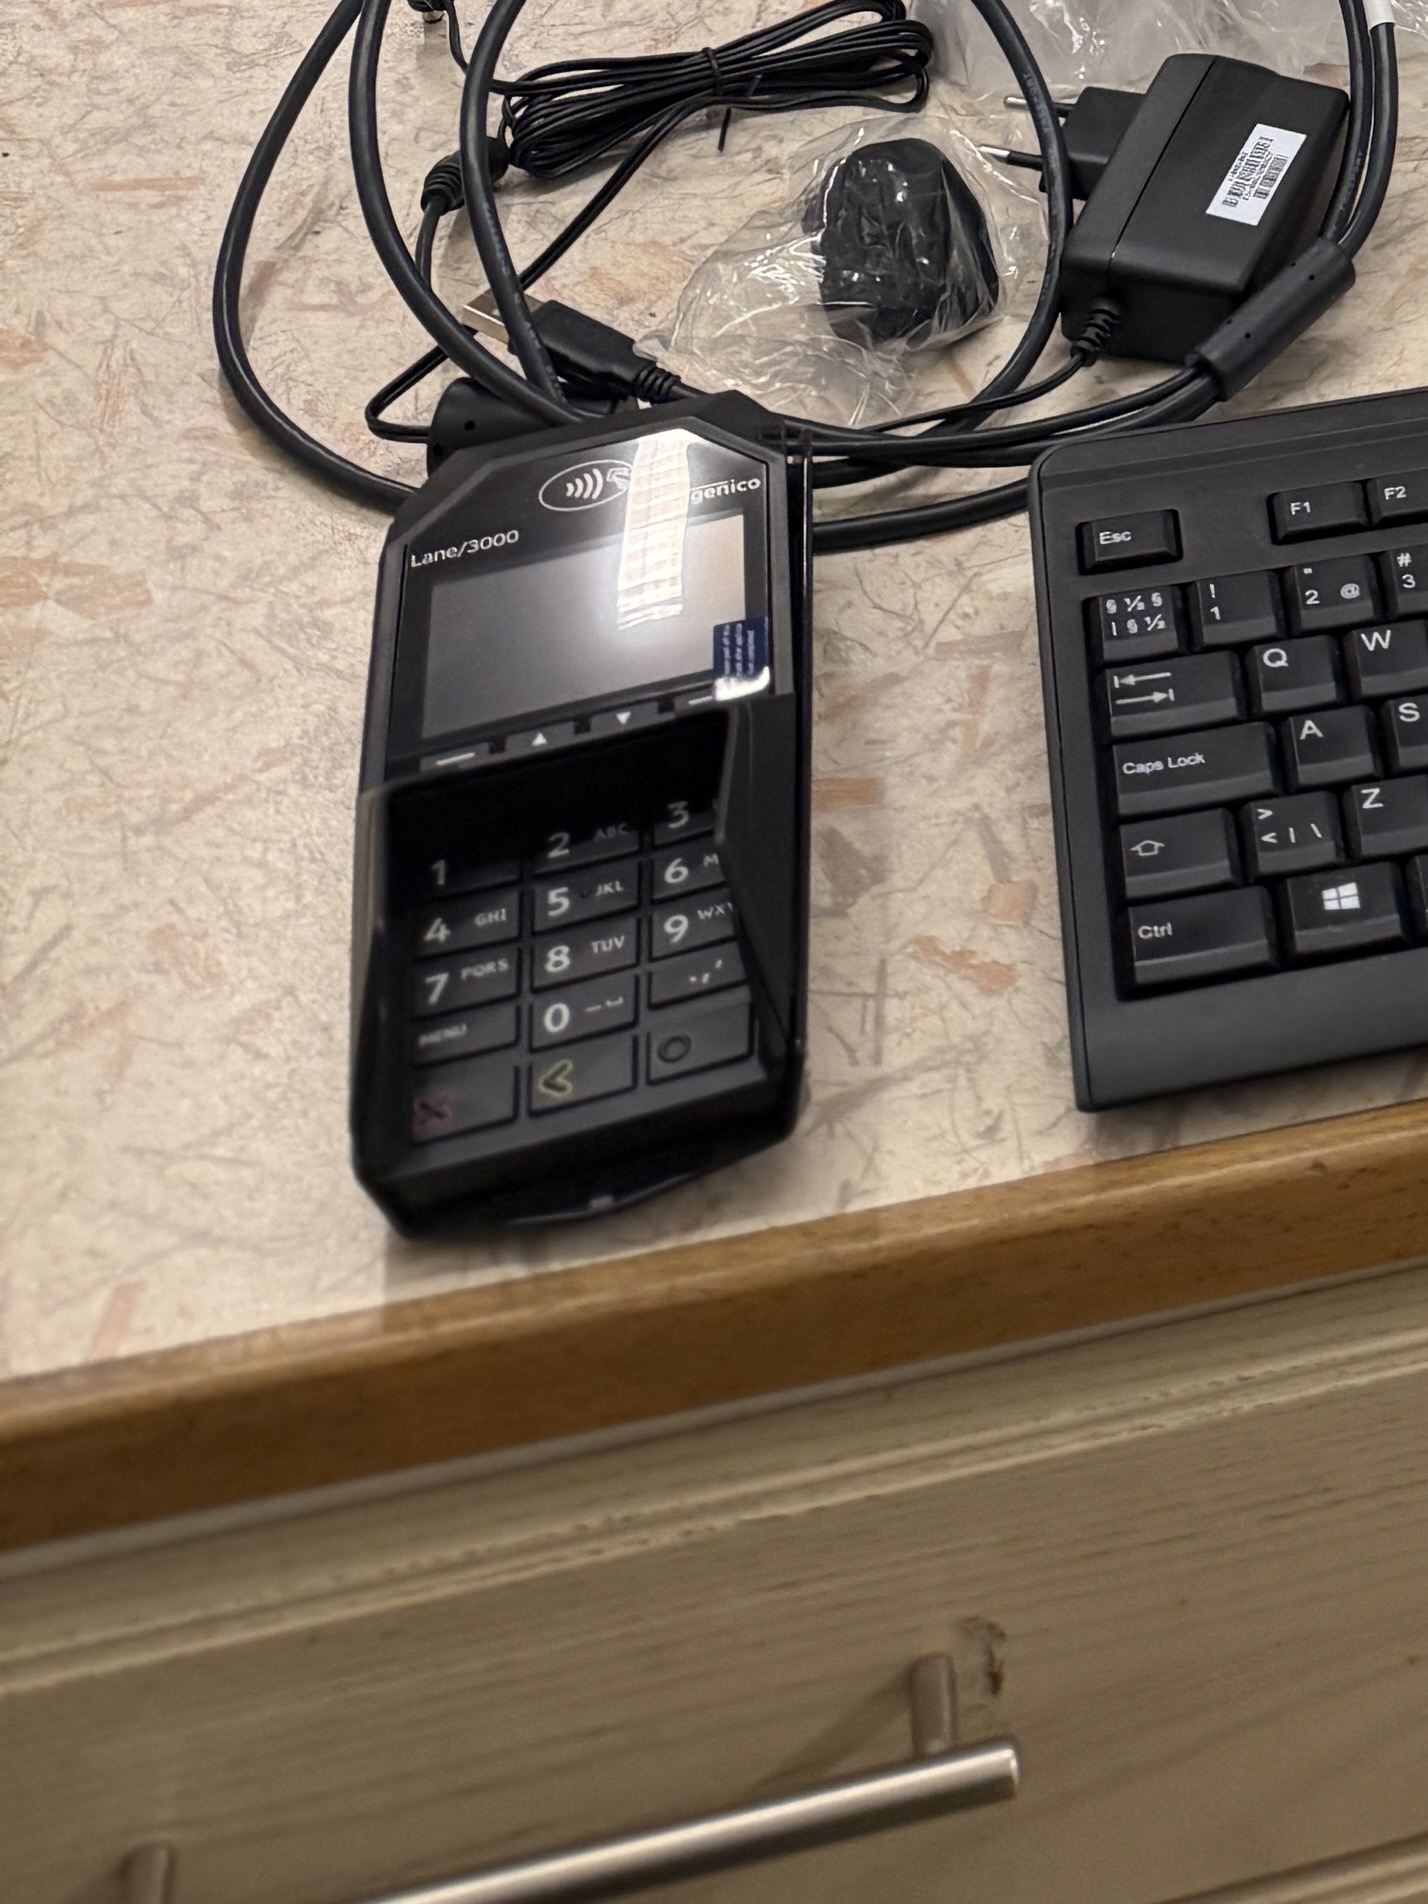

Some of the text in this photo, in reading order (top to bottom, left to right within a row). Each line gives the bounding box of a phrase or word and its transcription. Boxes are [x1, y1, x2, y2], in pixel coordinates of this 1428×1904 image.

[1099, 528, 1133, 545] Esc
[1289, 500, 1312, 515] F1
[1383, 485, 1407, 501] F2
[409, 528, 520, 569] Lane/3000
[1122, 751, 1206, 777] Caps Lock
[474, 908, 626, 954] GHI TUV
[1137, 922, 1174, 940] Ctrl
